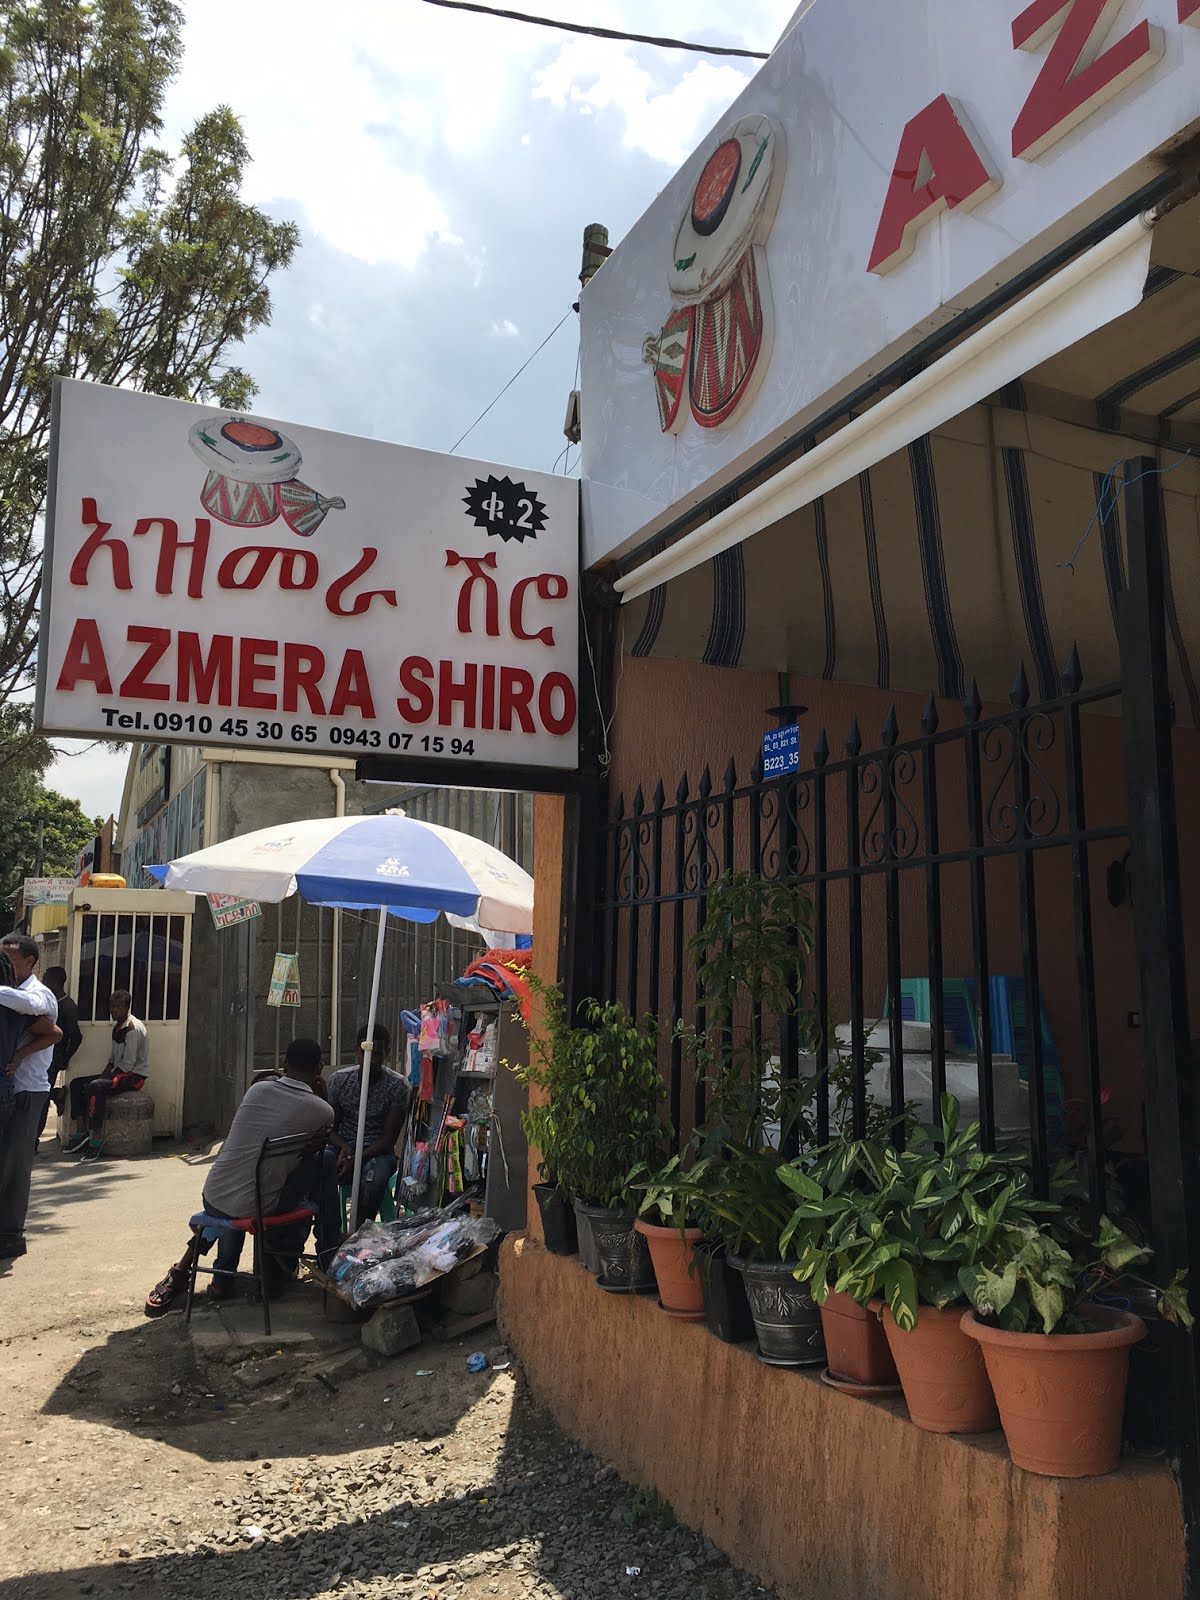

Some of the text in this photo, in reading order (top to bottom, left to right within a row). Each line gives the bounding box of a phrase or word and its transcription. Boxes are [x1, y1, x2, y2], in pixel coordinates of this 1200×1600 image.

[866, 0, 1200, 274] AZ
[444, 549, 568, 647] ሽሮ
[55, 618, 577, 736] AZMERA SHIRO
[219, 718, 249, 738] 45
[256, 720, 284, 740] 30
[290, 723, 318, 743] 65
[328, 726, 382, 748] 0943
[388, 732, 413, 750] 07
[420, 735, 445, 753] 15
[451, 738, 475, 756] 94
